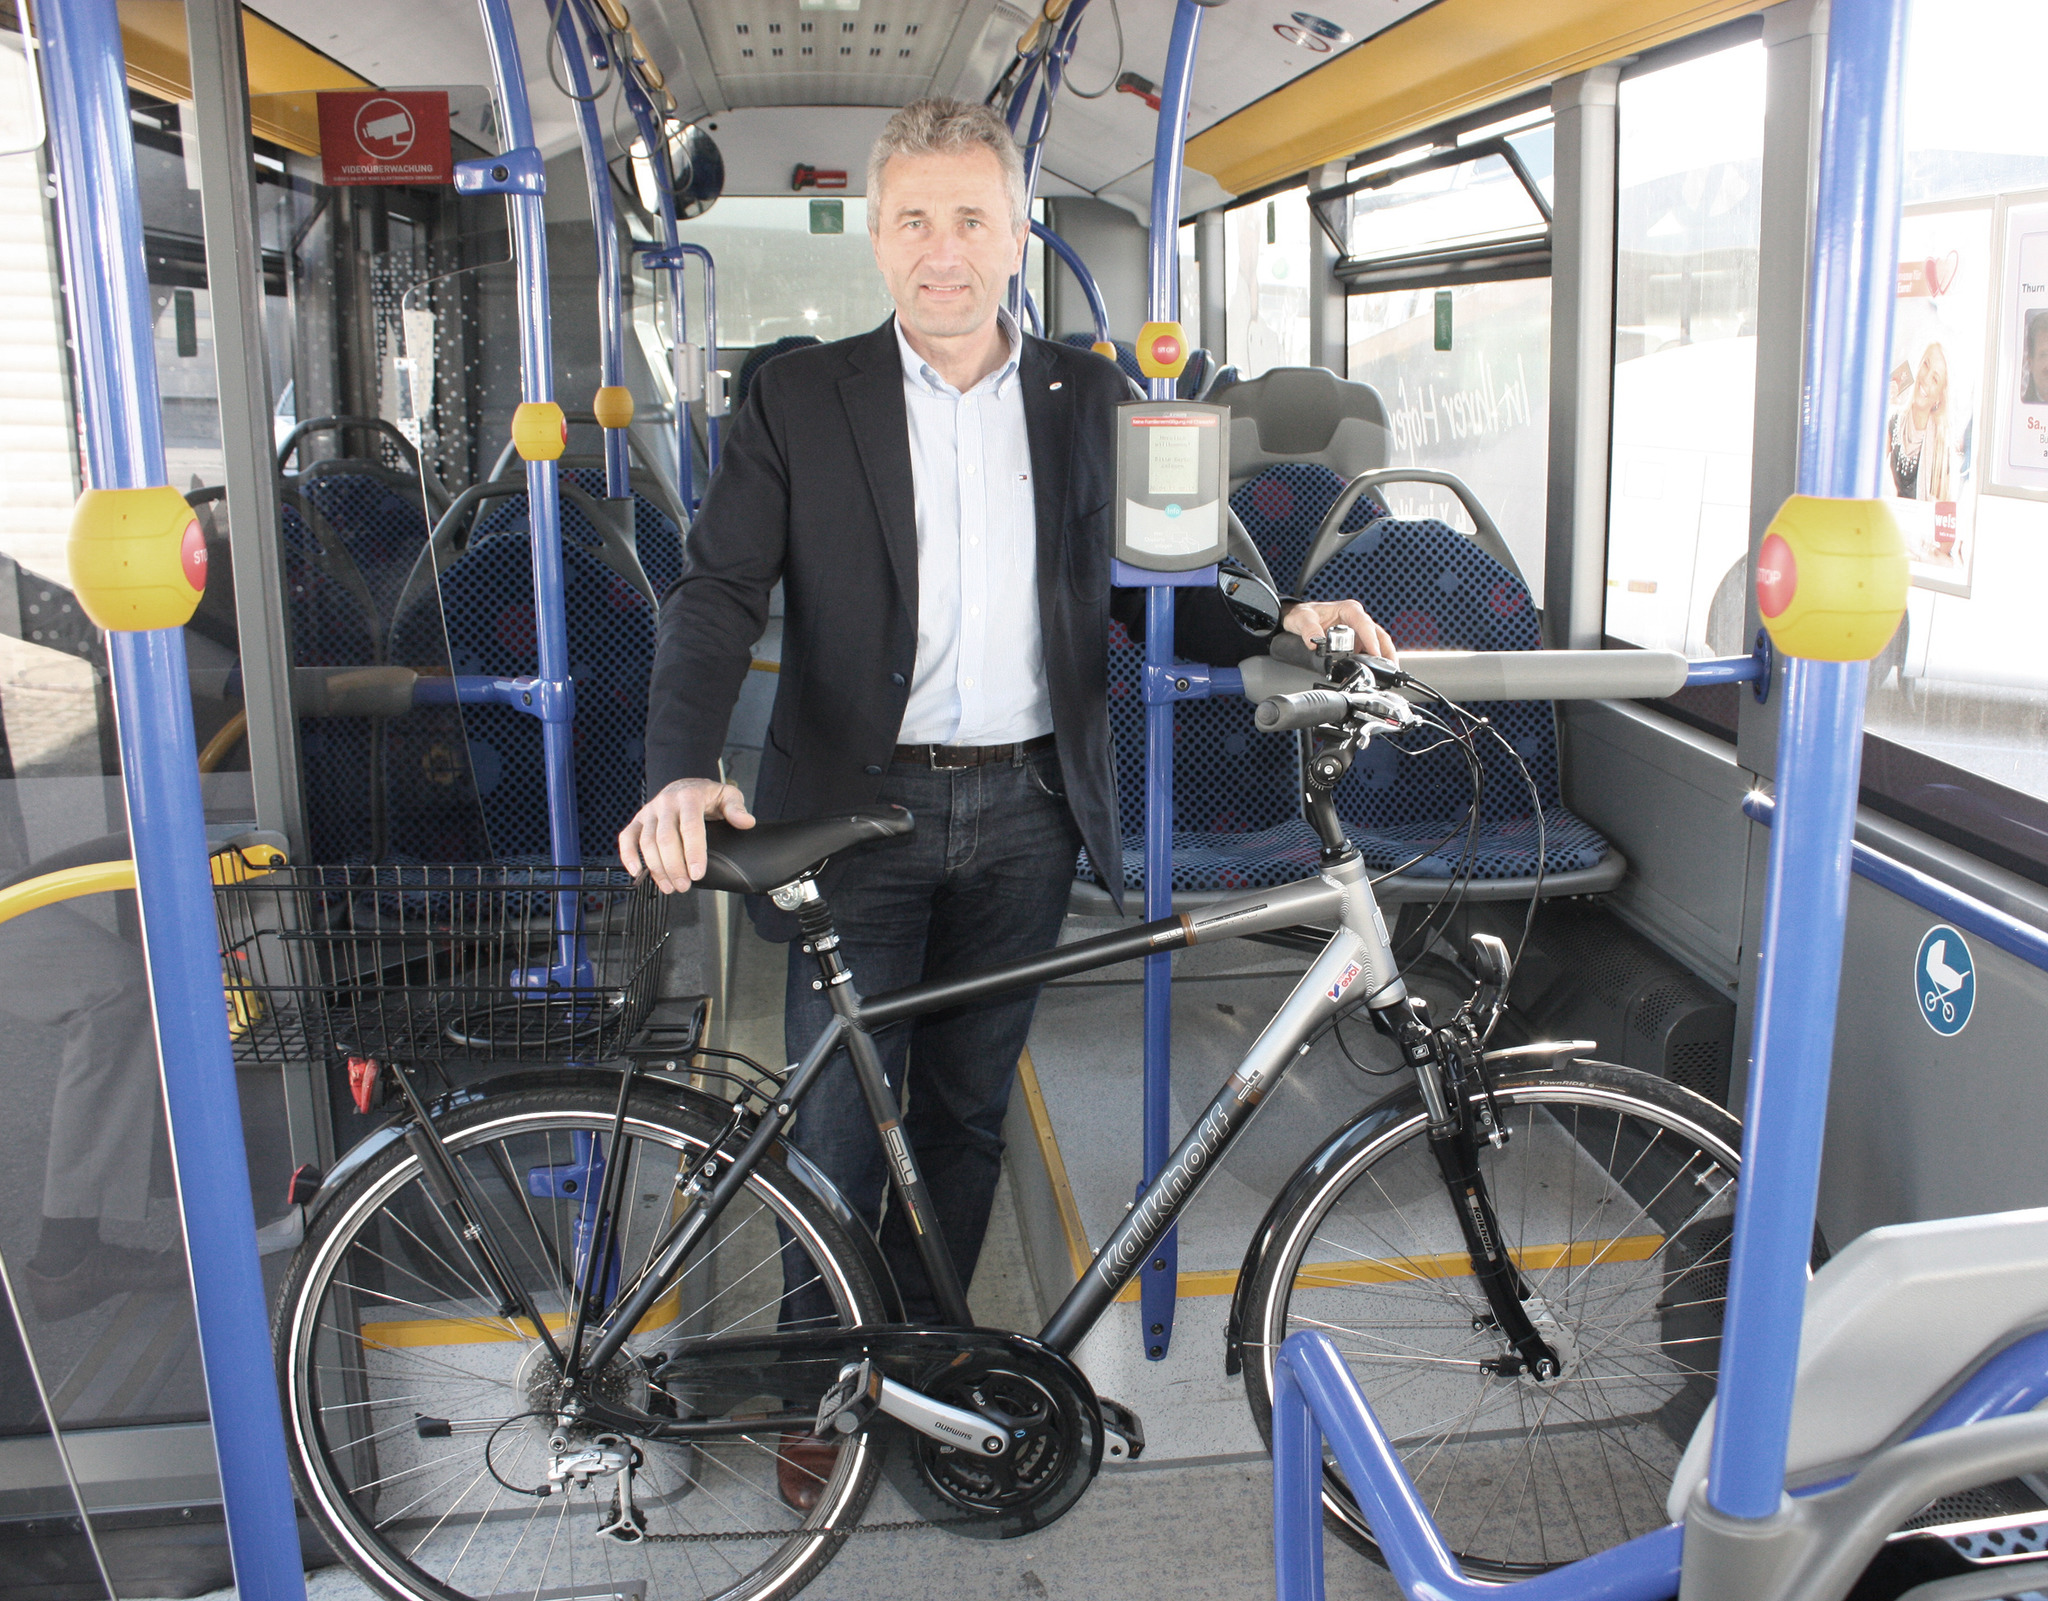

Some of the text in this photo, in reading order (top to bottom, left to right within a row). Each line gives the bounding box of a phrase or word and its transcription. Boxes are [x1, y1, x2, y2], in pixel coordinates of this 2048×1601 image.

[341, 163, 434, 174] VIDEOÜBERWACHUNG
[2022, 283, 2045, 293] Thurn
[1935, 513, 1956, 529] wels
[1097, 1101, 1231, 1290] Kalkhoff
[934, 1421, 973, 1440] SHIMANO
